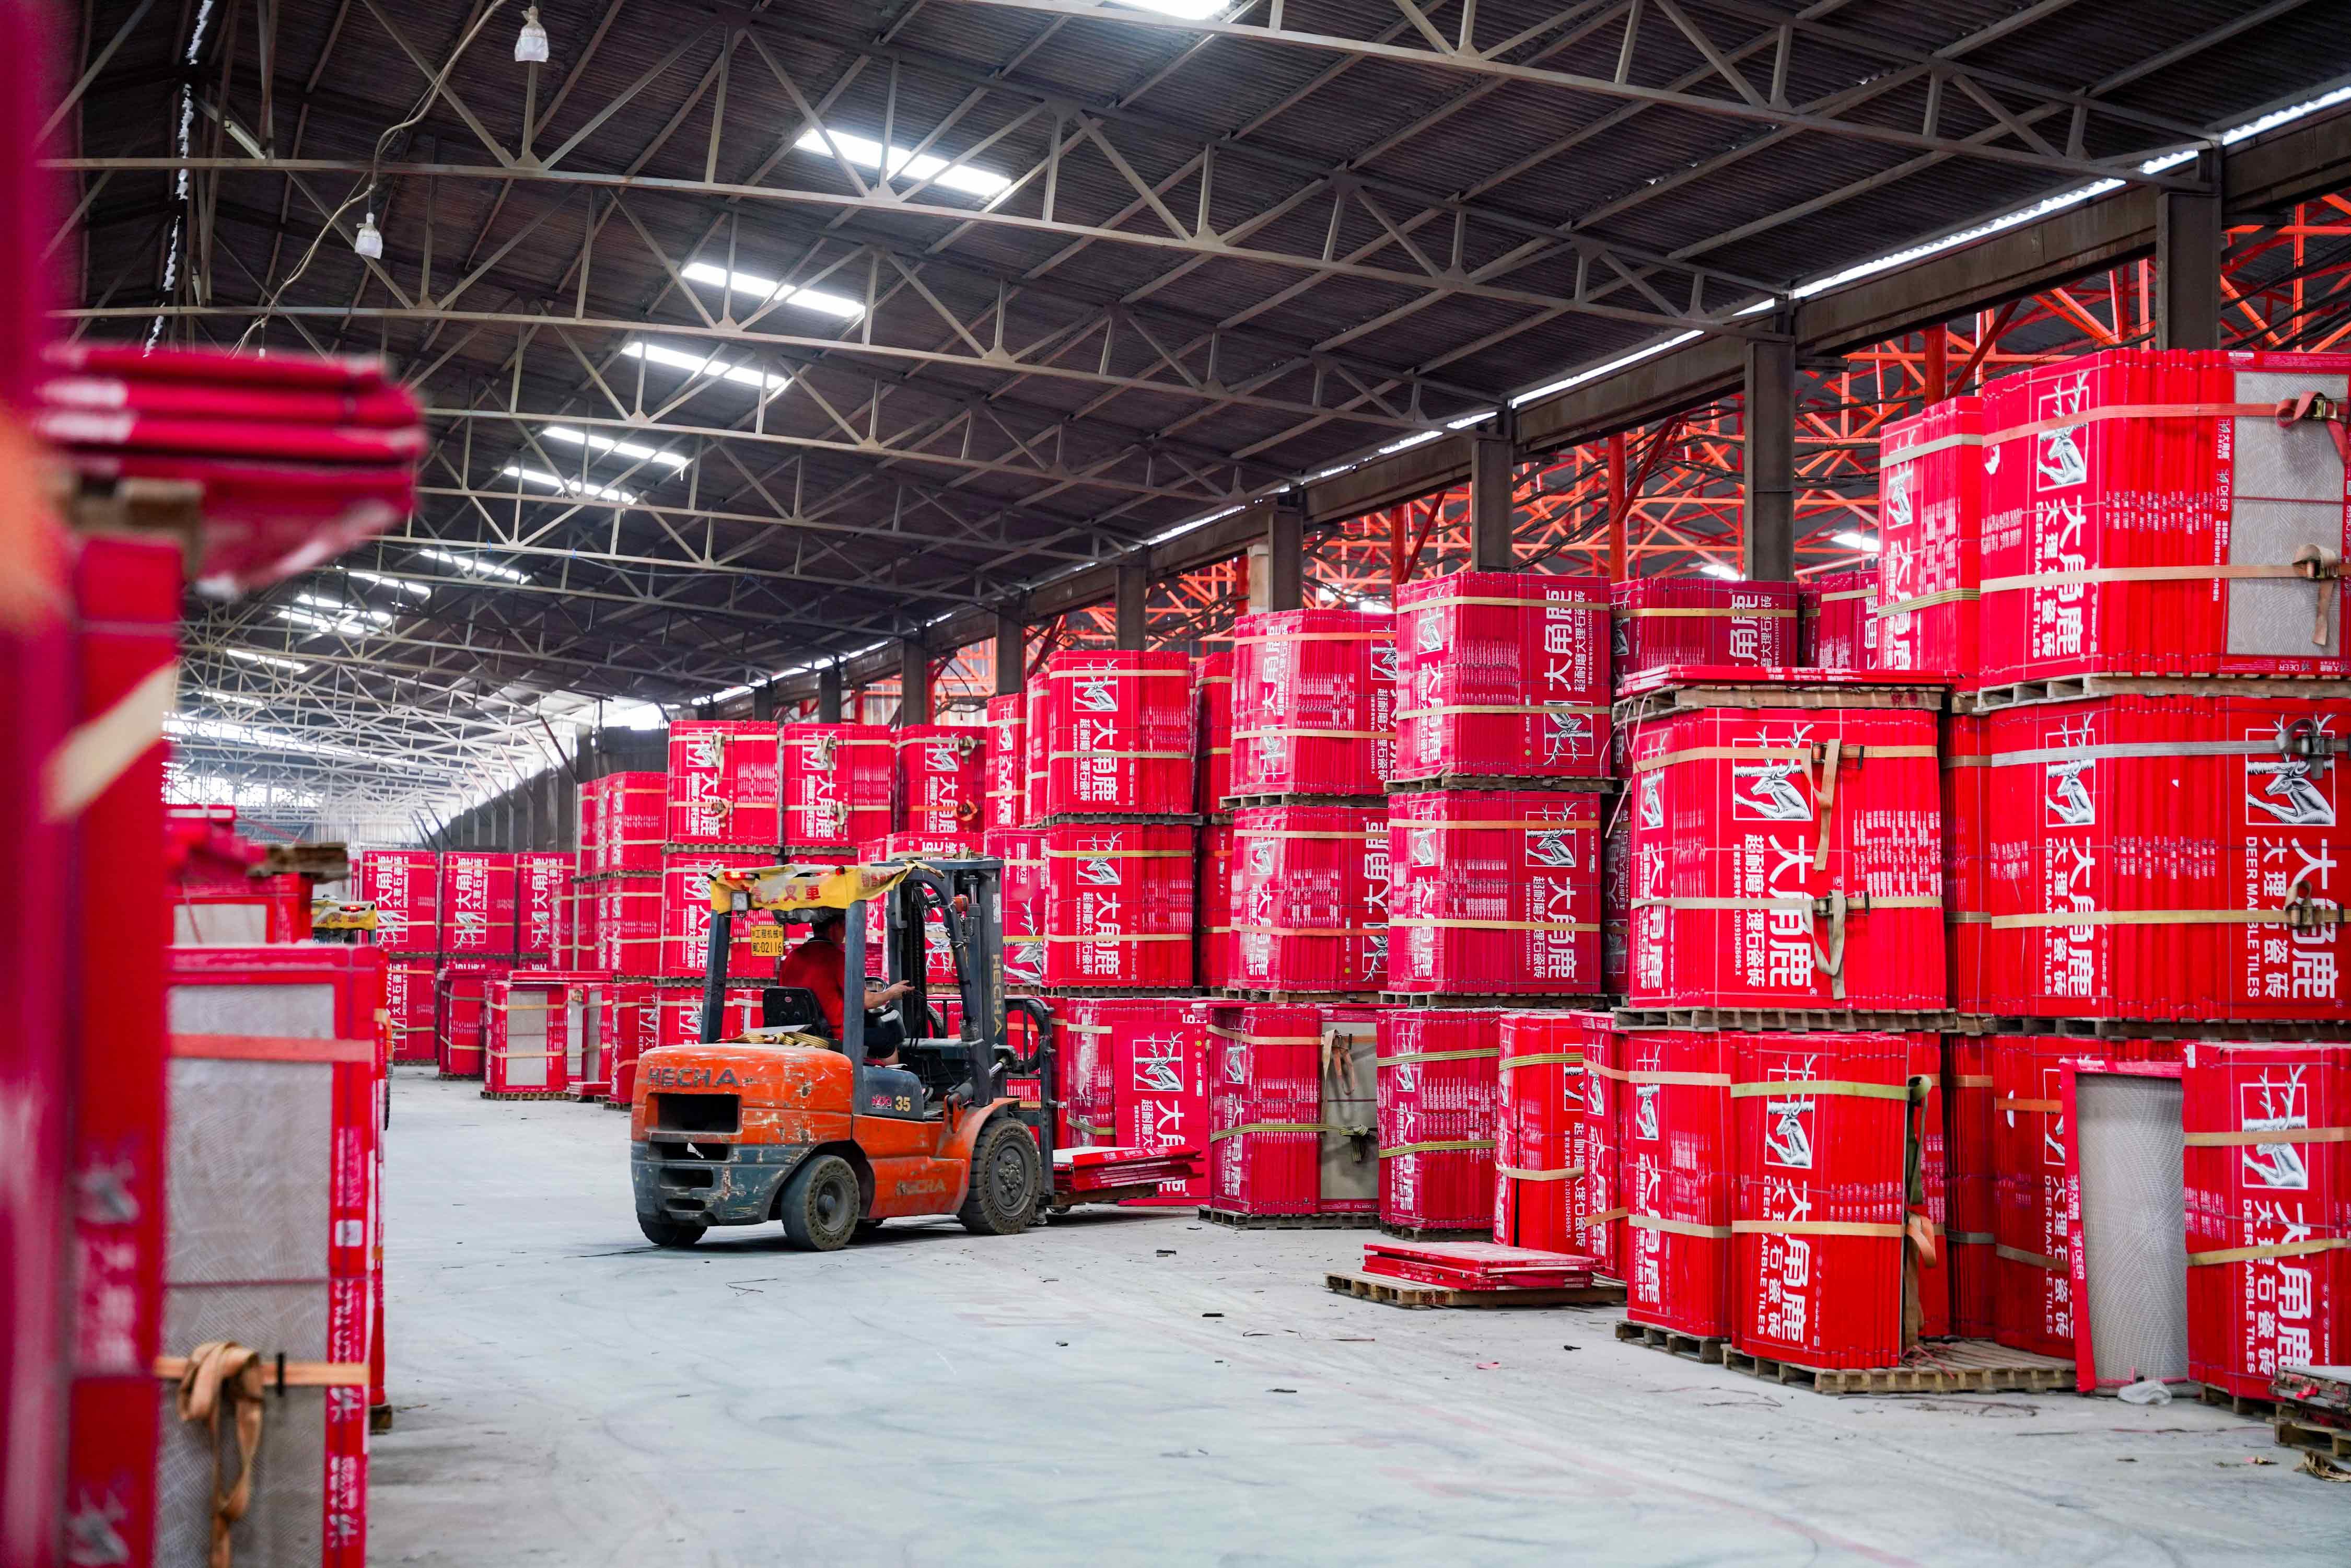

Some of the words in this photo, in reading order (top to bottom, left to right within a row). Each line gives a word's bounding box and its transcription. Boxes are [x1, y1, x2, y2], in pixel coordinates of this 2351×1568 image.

[2220, 486, 2229, 512] DEER
[2056, 494, 2086, 656] 大角鹿
[1544, 590, 1573, 692] 大角鹿
[1729, 595, 1758, 667] 角鹿
[1092, 719, 1118, 801] 大角鹿
[376, 856, 393, 908] 大角鹿
[456, 857, 473, 910] 大角鹿
[532, 858, 548, 909] 大角鹿
[1364, 822, 1389, 914] 大角鹿
[2246, 837, 2258, 879] DEER
[1095, 892, 1121, 974] 大角鹿
[1547, 877, 1576, 978] 大角鹿
[1648, 841, 1665, 989] 大角鹿
[1768, 834, 1814, 987] 大角鹿
[2068, 837, 2096, 996] 大角鹿
[2247, 883, 2259, 949] MABLE
[2291, 838, 2338, 998] 大角鹿
[992, 954, 1002, 1037] HECHA
[2247, 953, 2259, 997] TILES
[648, 1066, 740, 1087] HECHA
[895, 1096, 911, 1111] 35
[1644, 1154, 1660, 1304] 大角鹿
[2243, 1200, 2253, 1246] DEER
[1782, 1179, 1811, 1343] 大角鹿
[2075, 1250, 2084, 1280] DEER
[2245, 1260, 2255, 1321] ARBLE
[1758, 1292, 1766, 1334] TILES
[2247, 1326, 2255, 1373] TILES
